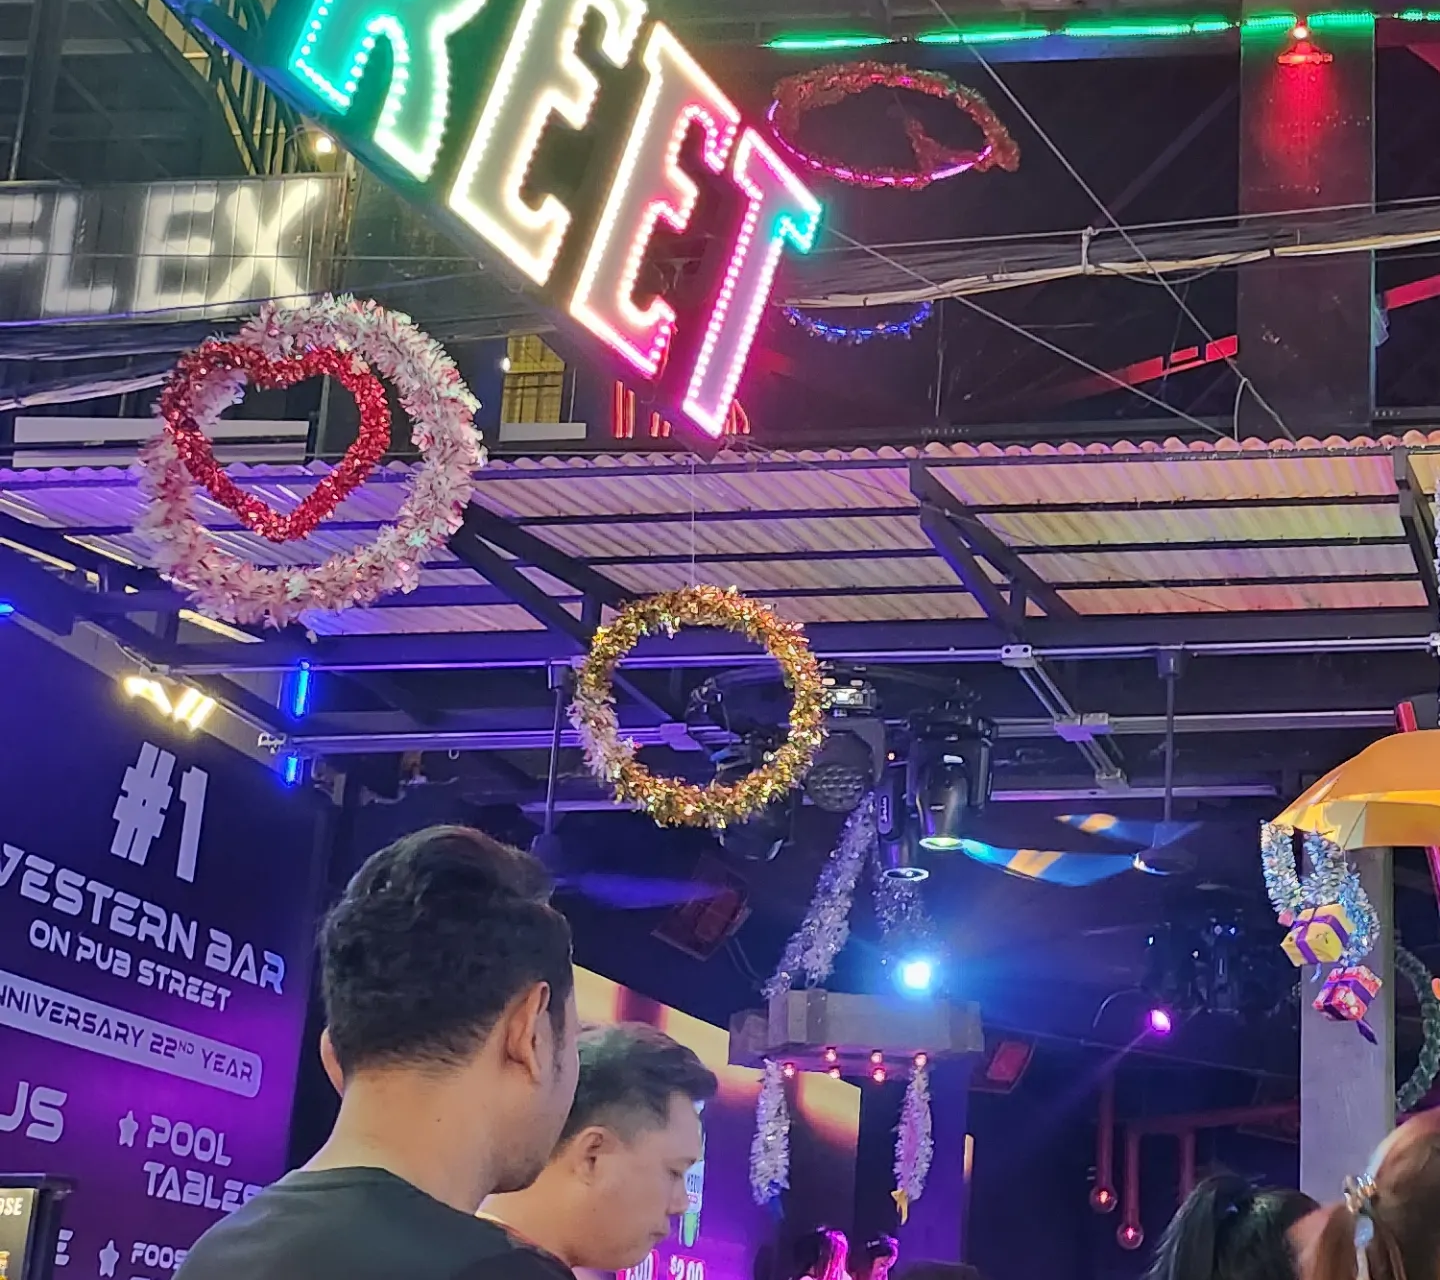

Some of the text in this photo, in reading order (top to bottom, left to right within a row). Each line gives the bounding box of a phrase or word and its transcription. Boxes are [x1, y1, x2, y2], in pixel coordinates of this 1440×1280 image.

[110, 740, 209, 883] #1
[29, 918, 232, 1012] ON PUB STREET
[204, 927, 286, 995] BAR
[201, 1047, 254, 1083] YEAR
[146, 1114, 232, 1167] POOL
